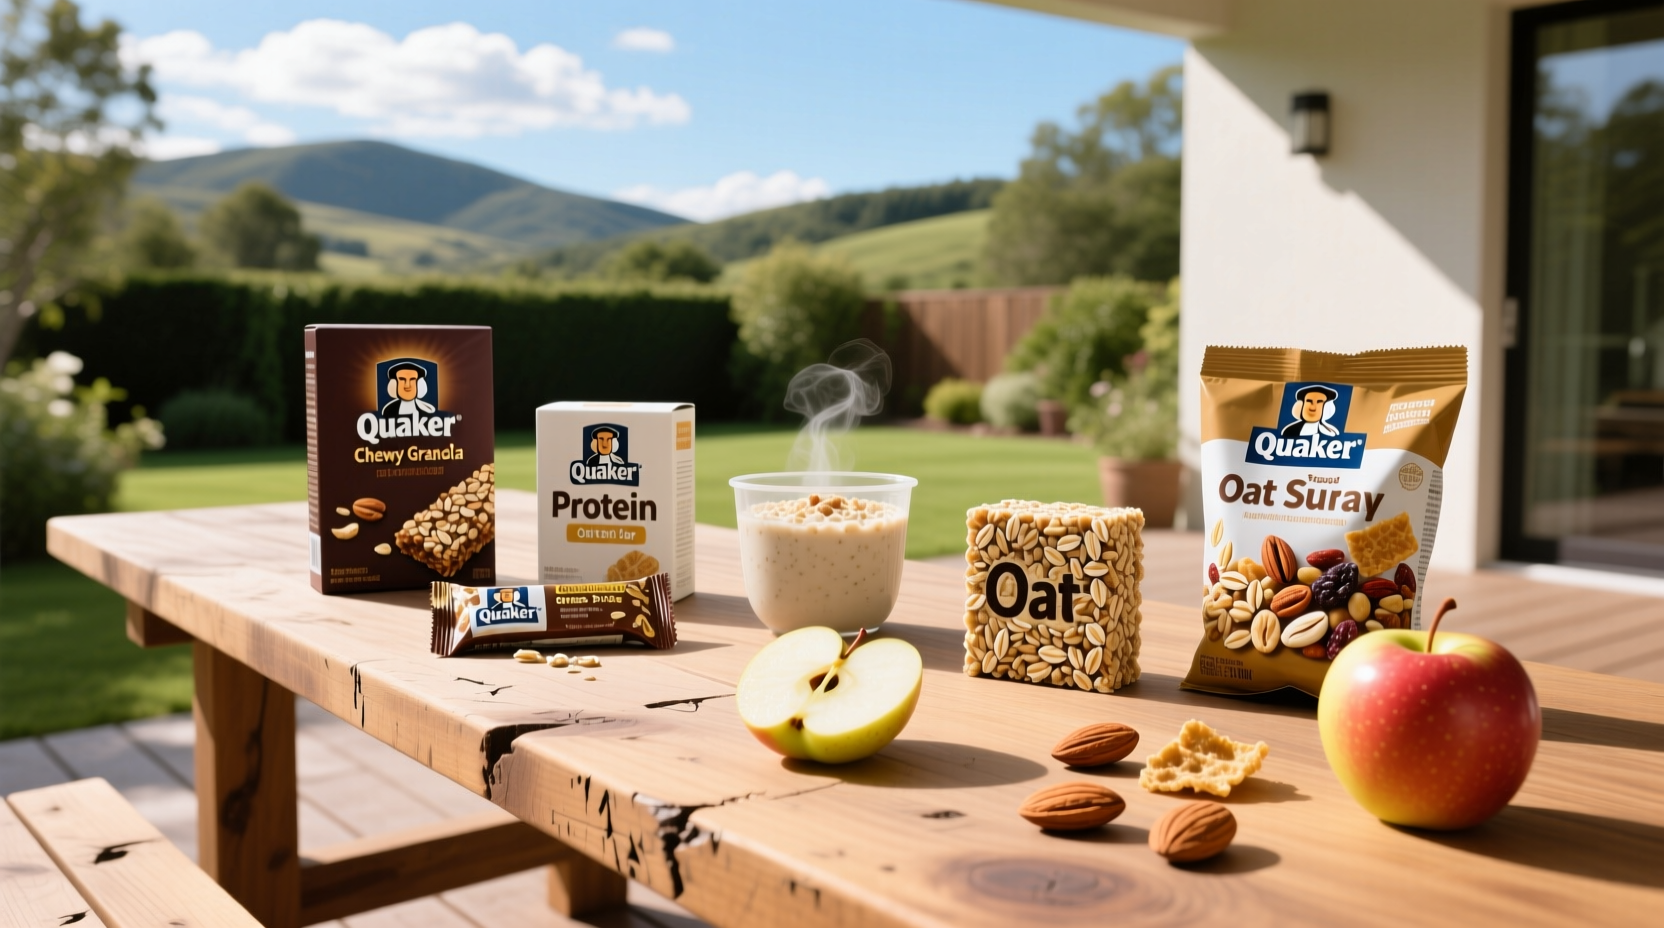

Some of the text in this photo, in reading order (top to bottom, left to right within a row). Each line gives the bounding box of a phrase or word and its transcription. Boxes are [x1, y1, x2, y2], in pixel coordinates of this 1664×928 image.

[356, 411, 456, 445] Quaker
[354, 443, 464, 466] Chewy Granola
[1254, 431, 1357, 461] Quaker
[571, 461, 637, 484] Quaker
[552, 490, 657, 522] Protein
[1218, 473, 1277, 503] Oat
[1283, 478, 1385, 522] Suray
[985, 561, 1080, 623] Oat
